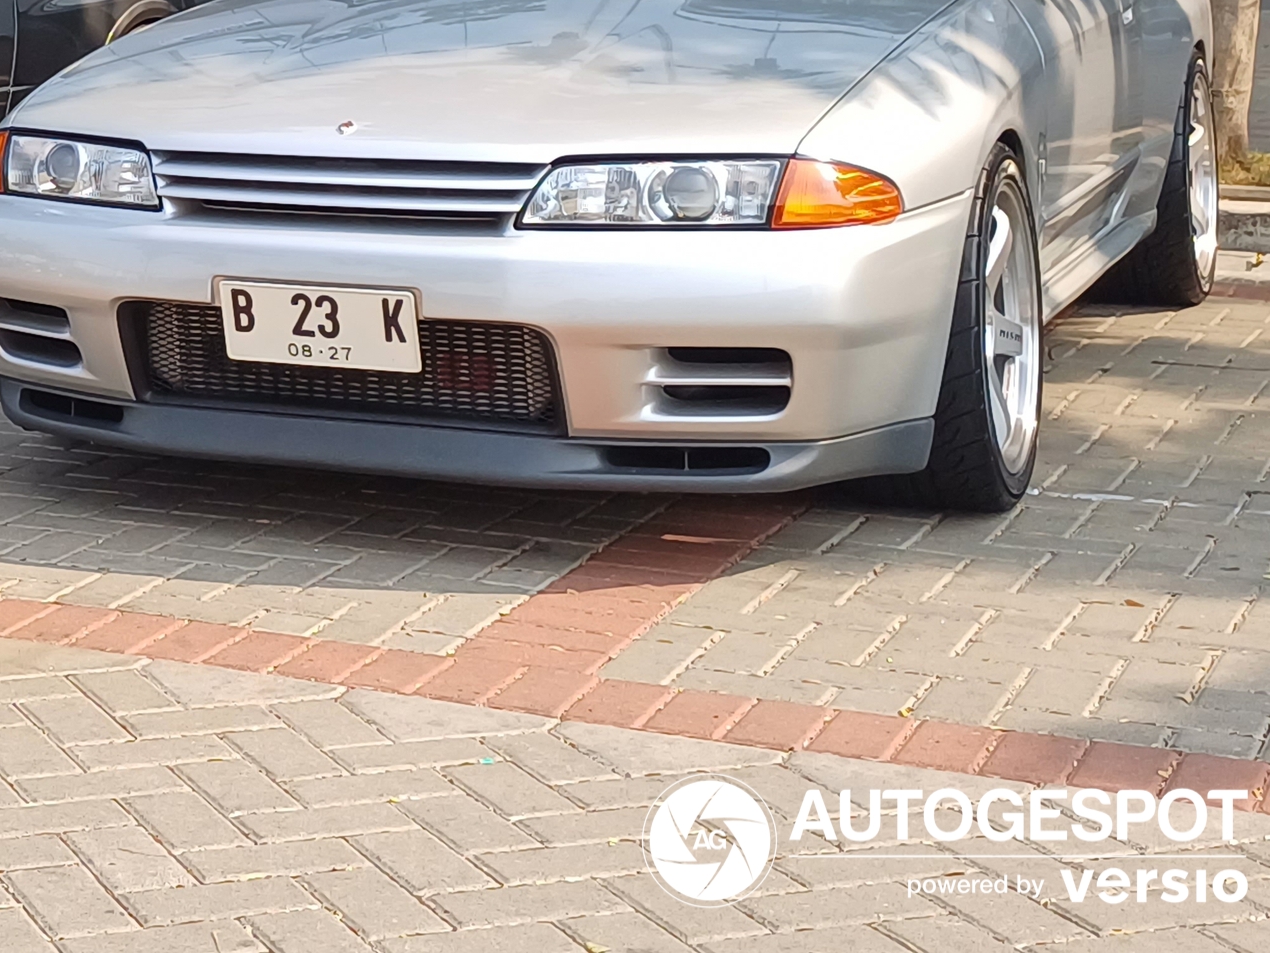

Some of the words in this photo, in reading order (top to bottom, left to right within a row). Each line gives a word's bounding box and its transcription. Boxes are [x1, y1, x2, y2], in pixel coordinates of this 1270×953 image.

[231, 288, 255, 332] B
[291, 293, 341, 339] 23
[382, 298, 407, 343] K
